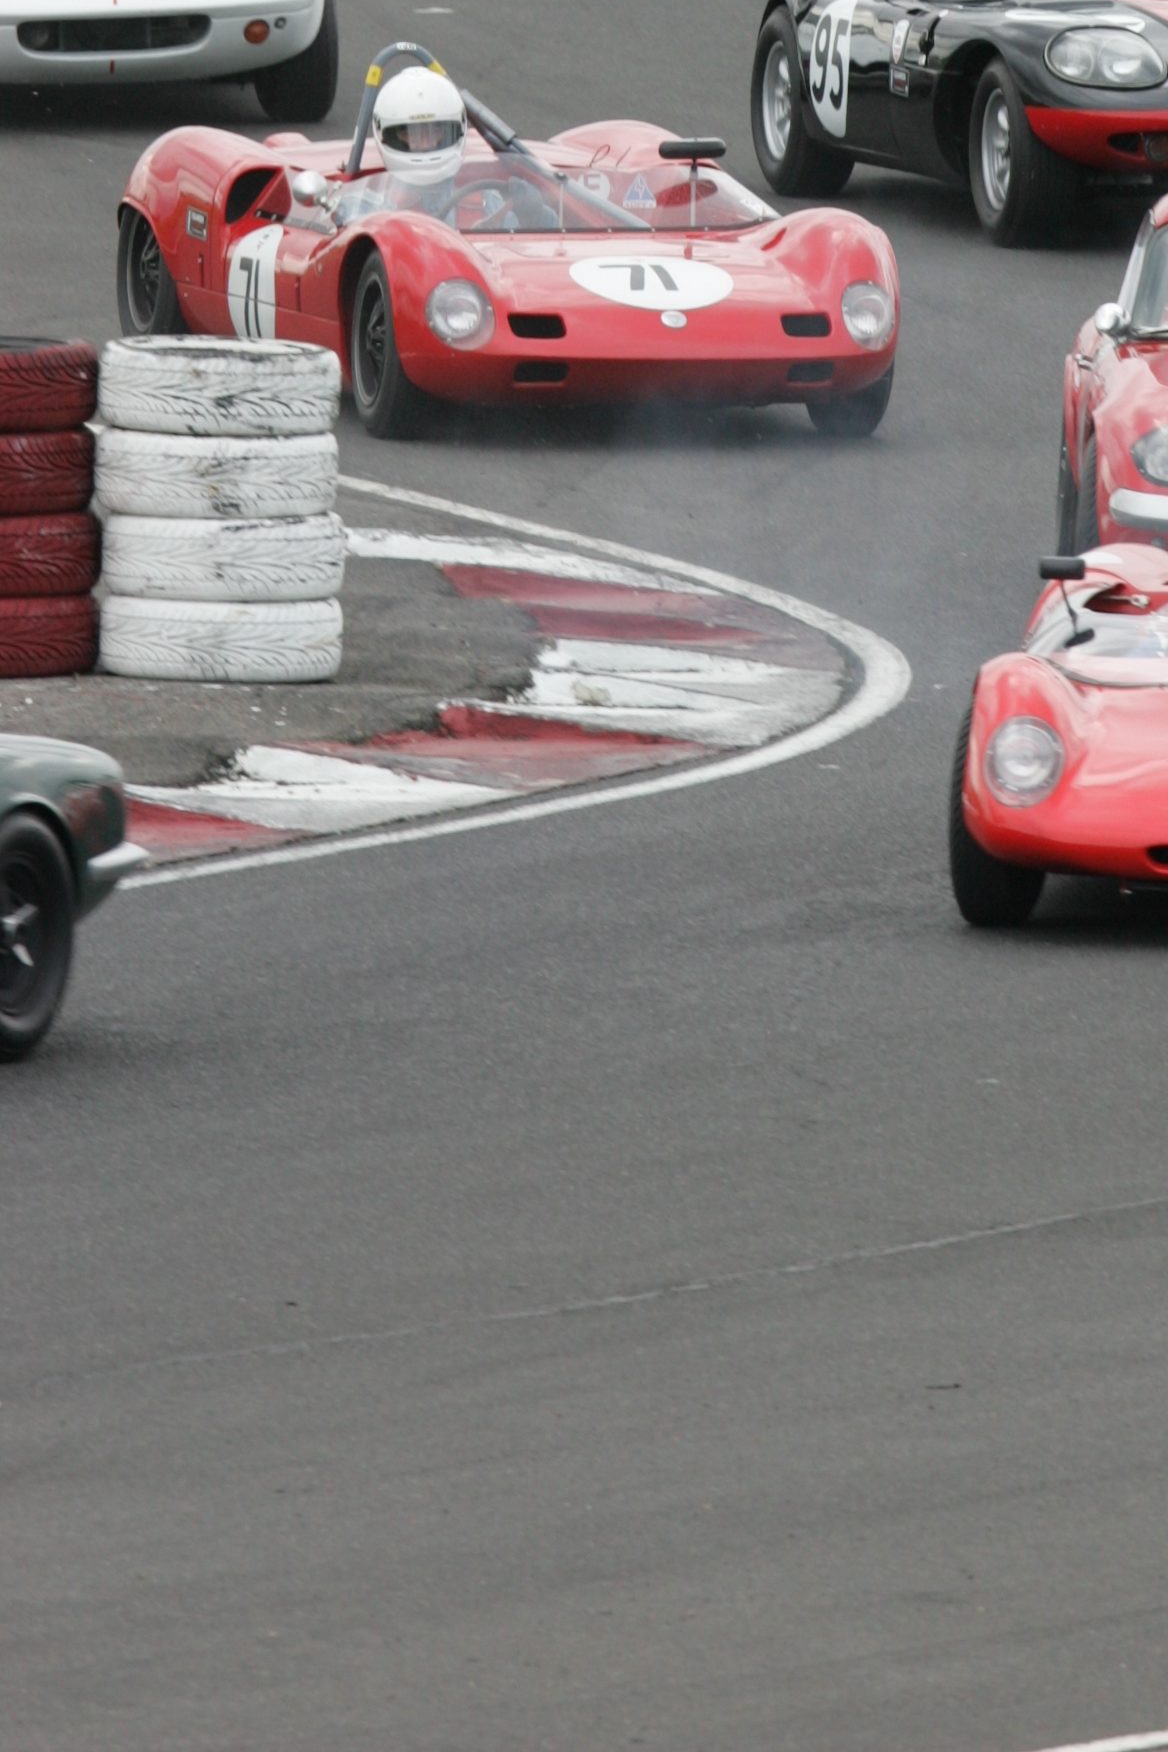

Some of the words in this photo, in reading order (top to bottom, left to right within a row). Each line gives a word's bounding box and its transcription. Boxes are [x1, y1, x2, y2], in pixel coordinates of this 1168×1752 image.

[811, 14, 850, 111] 95
[239, 256, 263, 343] 71
[597, 264, 679, 291] 71
